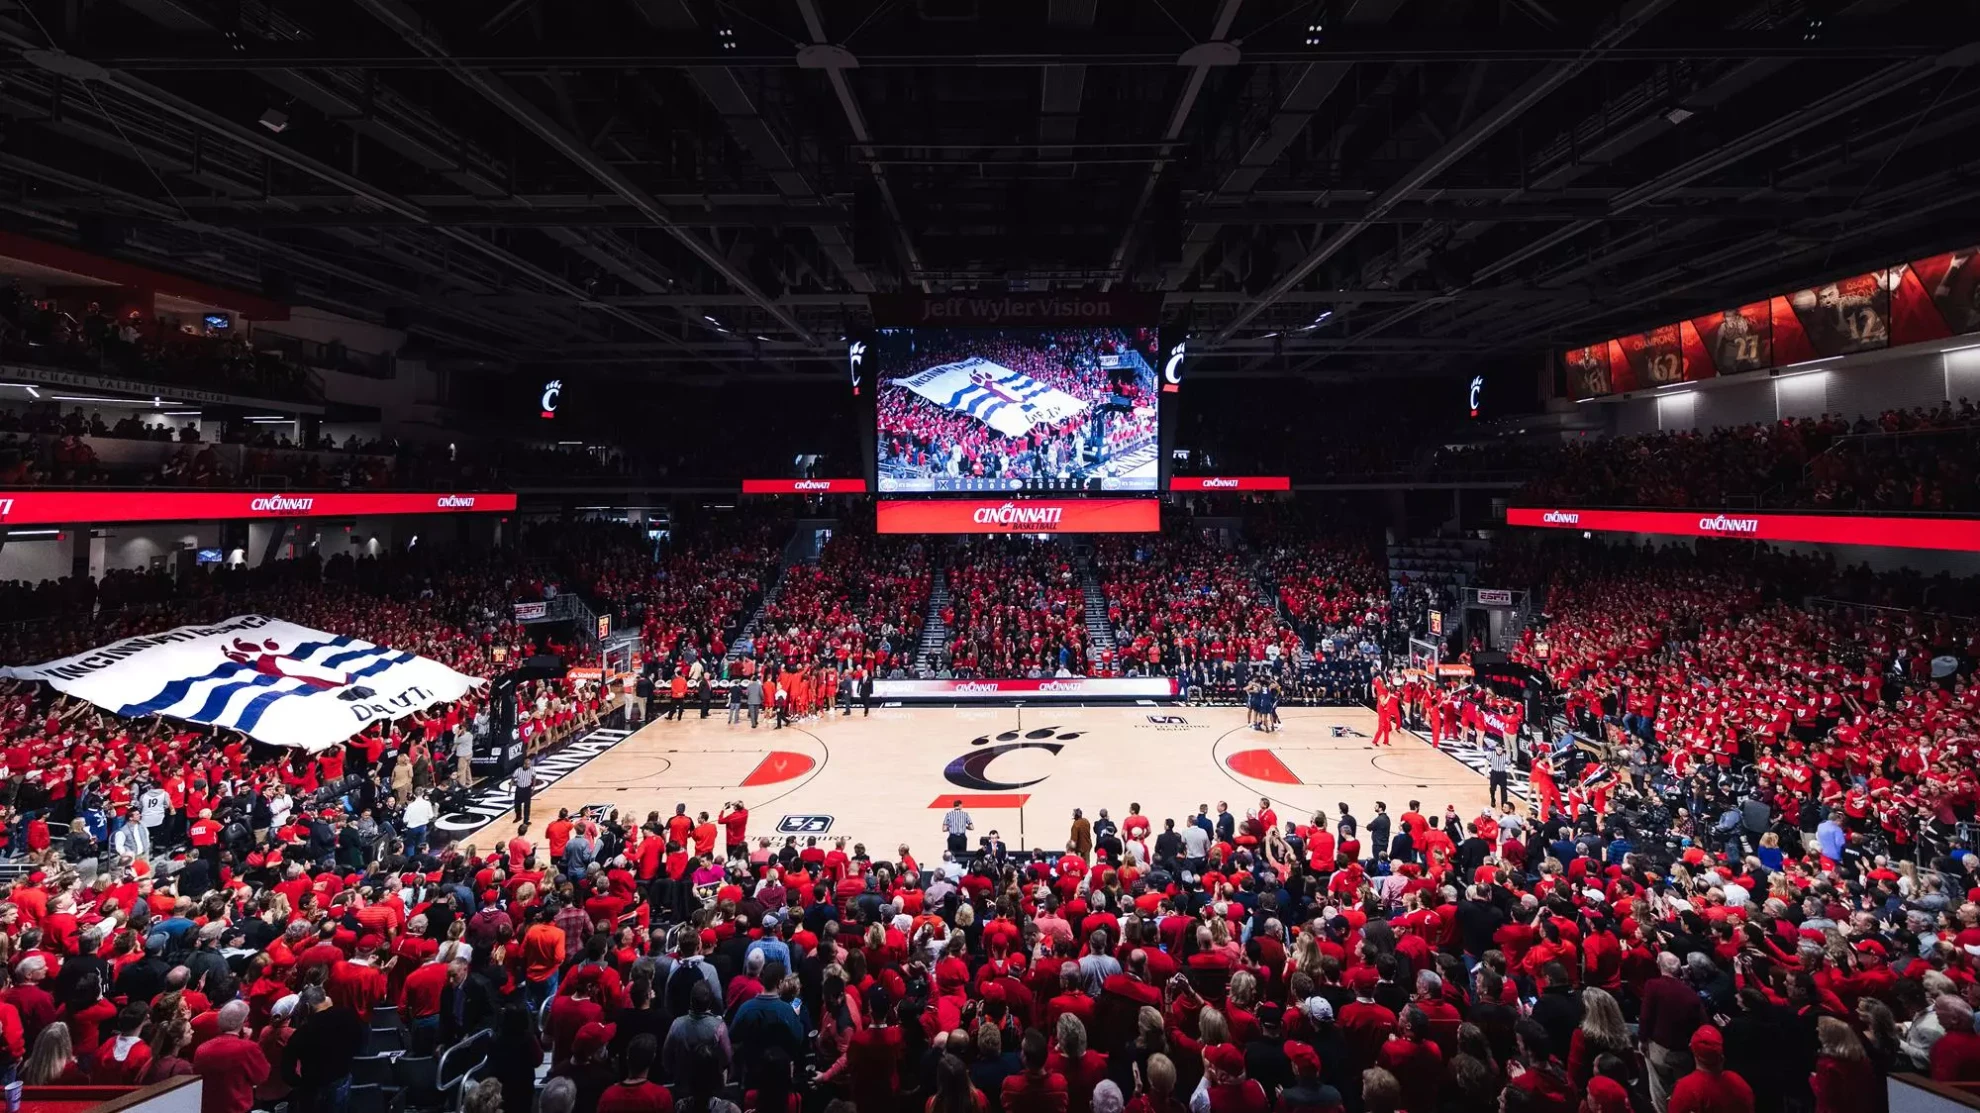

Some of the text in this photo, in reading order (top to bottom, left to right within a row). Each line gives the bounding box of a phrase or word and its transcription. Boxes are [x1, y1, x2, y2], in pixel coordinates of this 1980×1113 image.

[922, 297, 966, 321] Jeff
[16, 368, 88, 385] MICHAEL
[251, 494, 313, 511] CINCINNATI
[438, 495, 474, 507] CINCINNATI
[973, 503, 1062, 524] CINCINNATI
[1544, 511, 1578, 524] CINCINNATI
[1012, 522, 1057, 530] BASKETBALL
[1699, 515, 1758, 532] CINCINNATI
[1480, 592, 1509, 601] ESPN
[515, 605, 545, 615] ESPN
[34, 629, 197, 681] INCINNATI
[956, 681, 998, 692] CINCINNATI
[1039, 681, 1081, 692] CINCINNATI
[148, 798, 158, 808] 19
